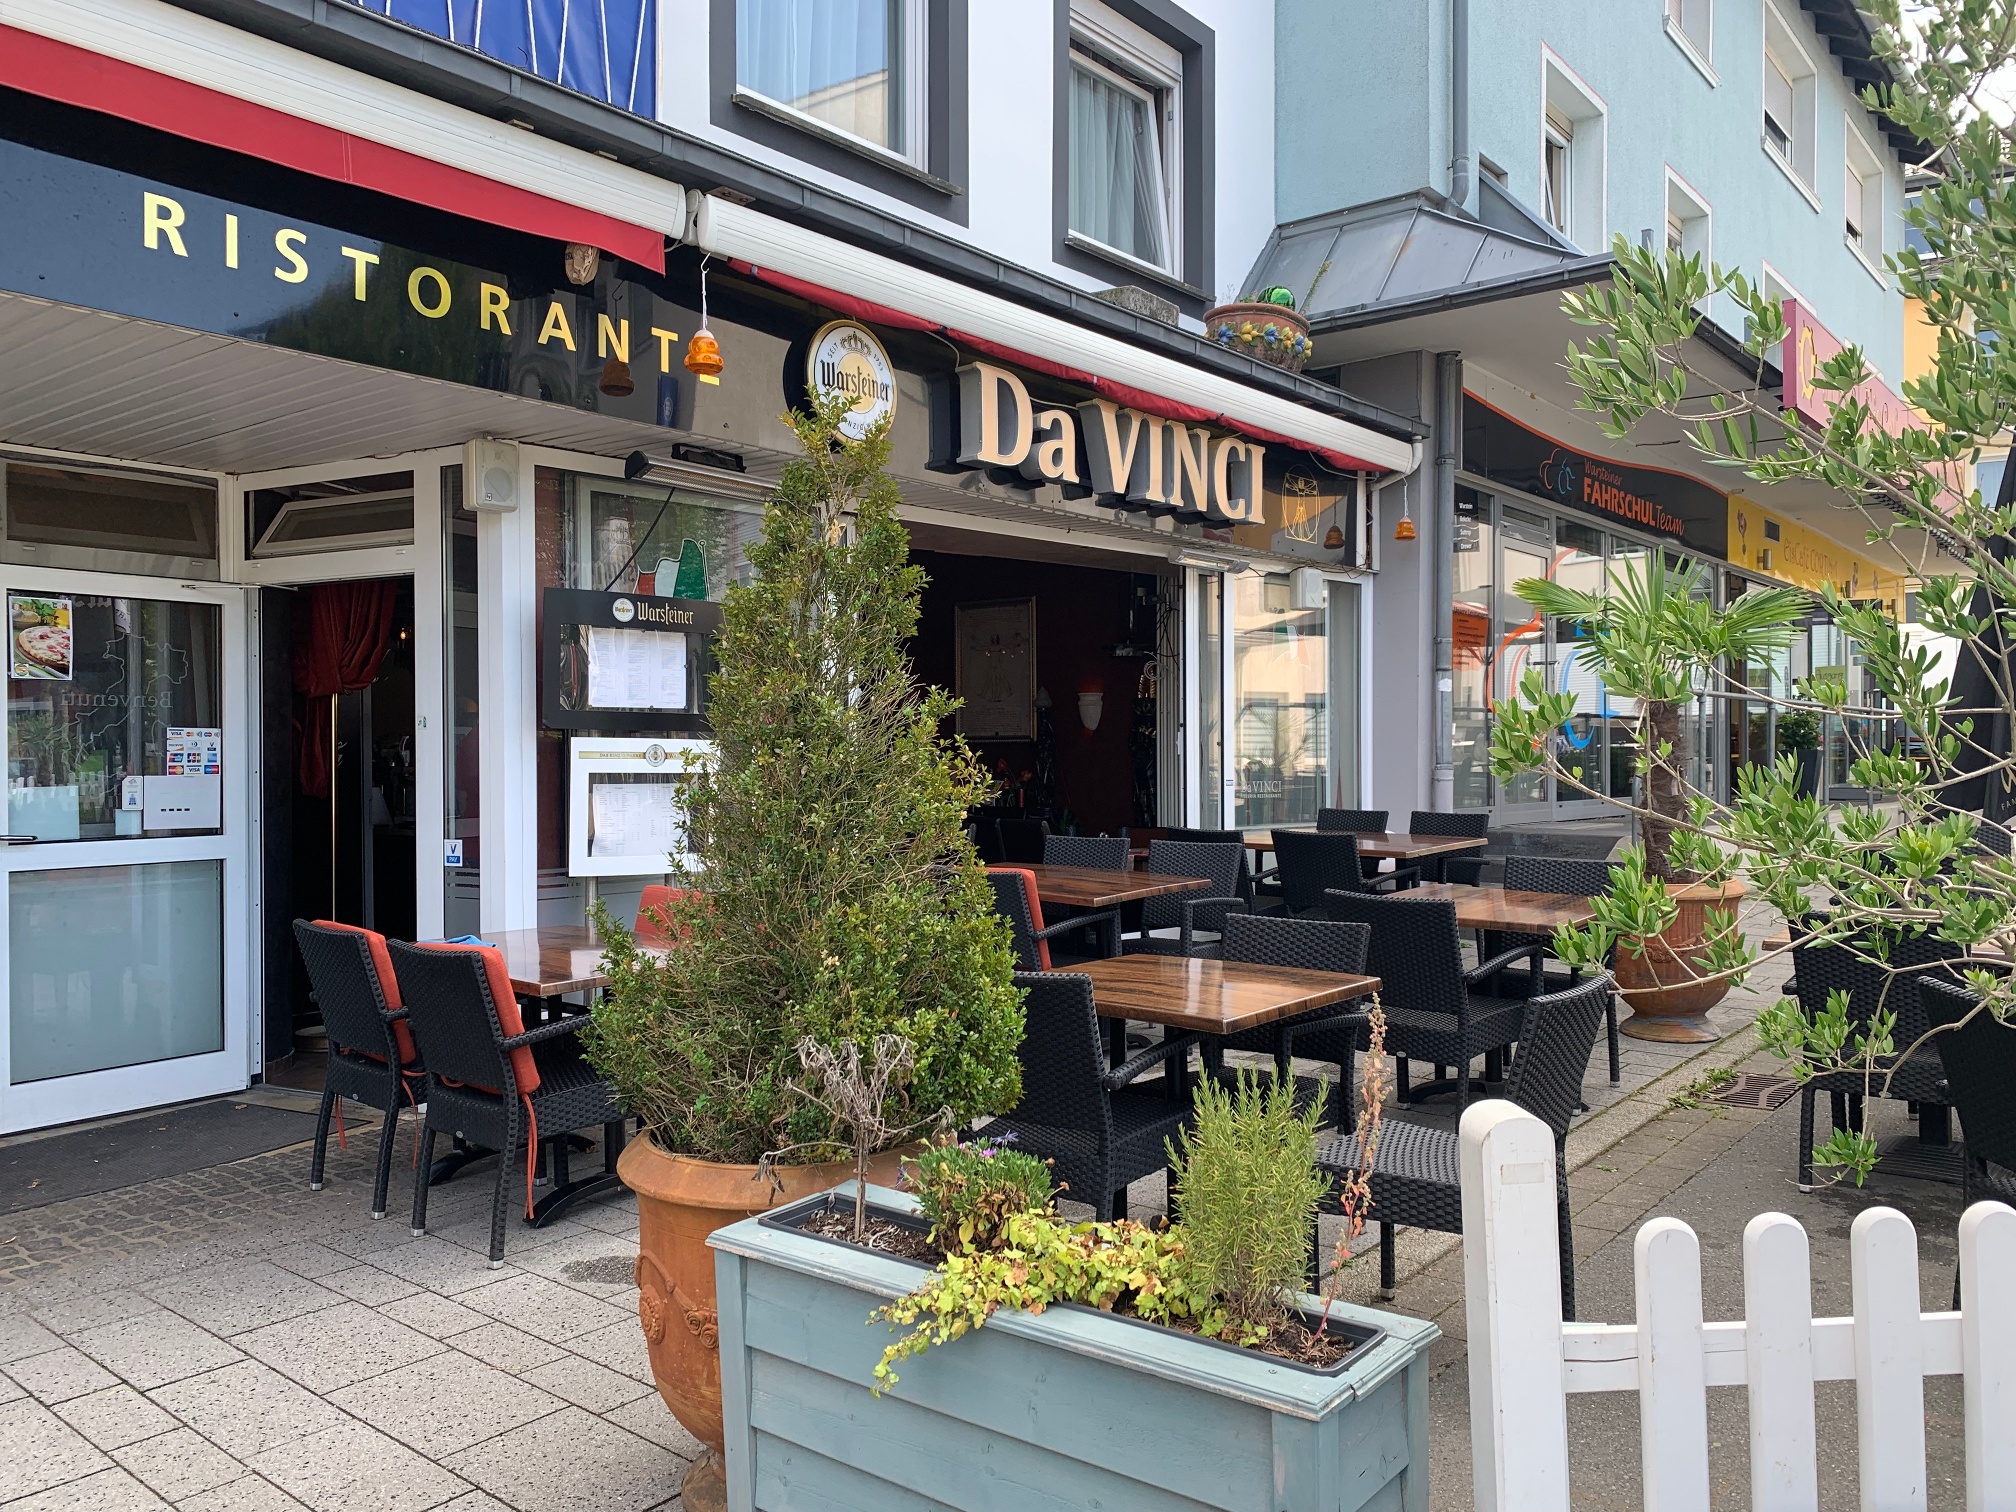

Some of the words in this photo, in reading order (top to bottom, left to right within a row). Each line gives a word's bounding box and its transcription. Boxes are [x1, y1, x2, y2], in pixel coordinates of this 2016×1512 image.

[143, 191, 720, 386] RISTORANT
[827, 341, 840, 359] SEIT
[820, 359, 890, 402] Warsteiner
[978, 361, 1080, 484] Da
[1097, 398, 1266, 525] VINCI
[1584, 458, 1622, 486] Warsteiner
[1583, 476, 1655, 527] FAHRSCHUL
[1655, 504, 1685, 536] Team
[637, 601, 694, 626] Warsteiner
[1252, 780, 1282, 792] VINCI
